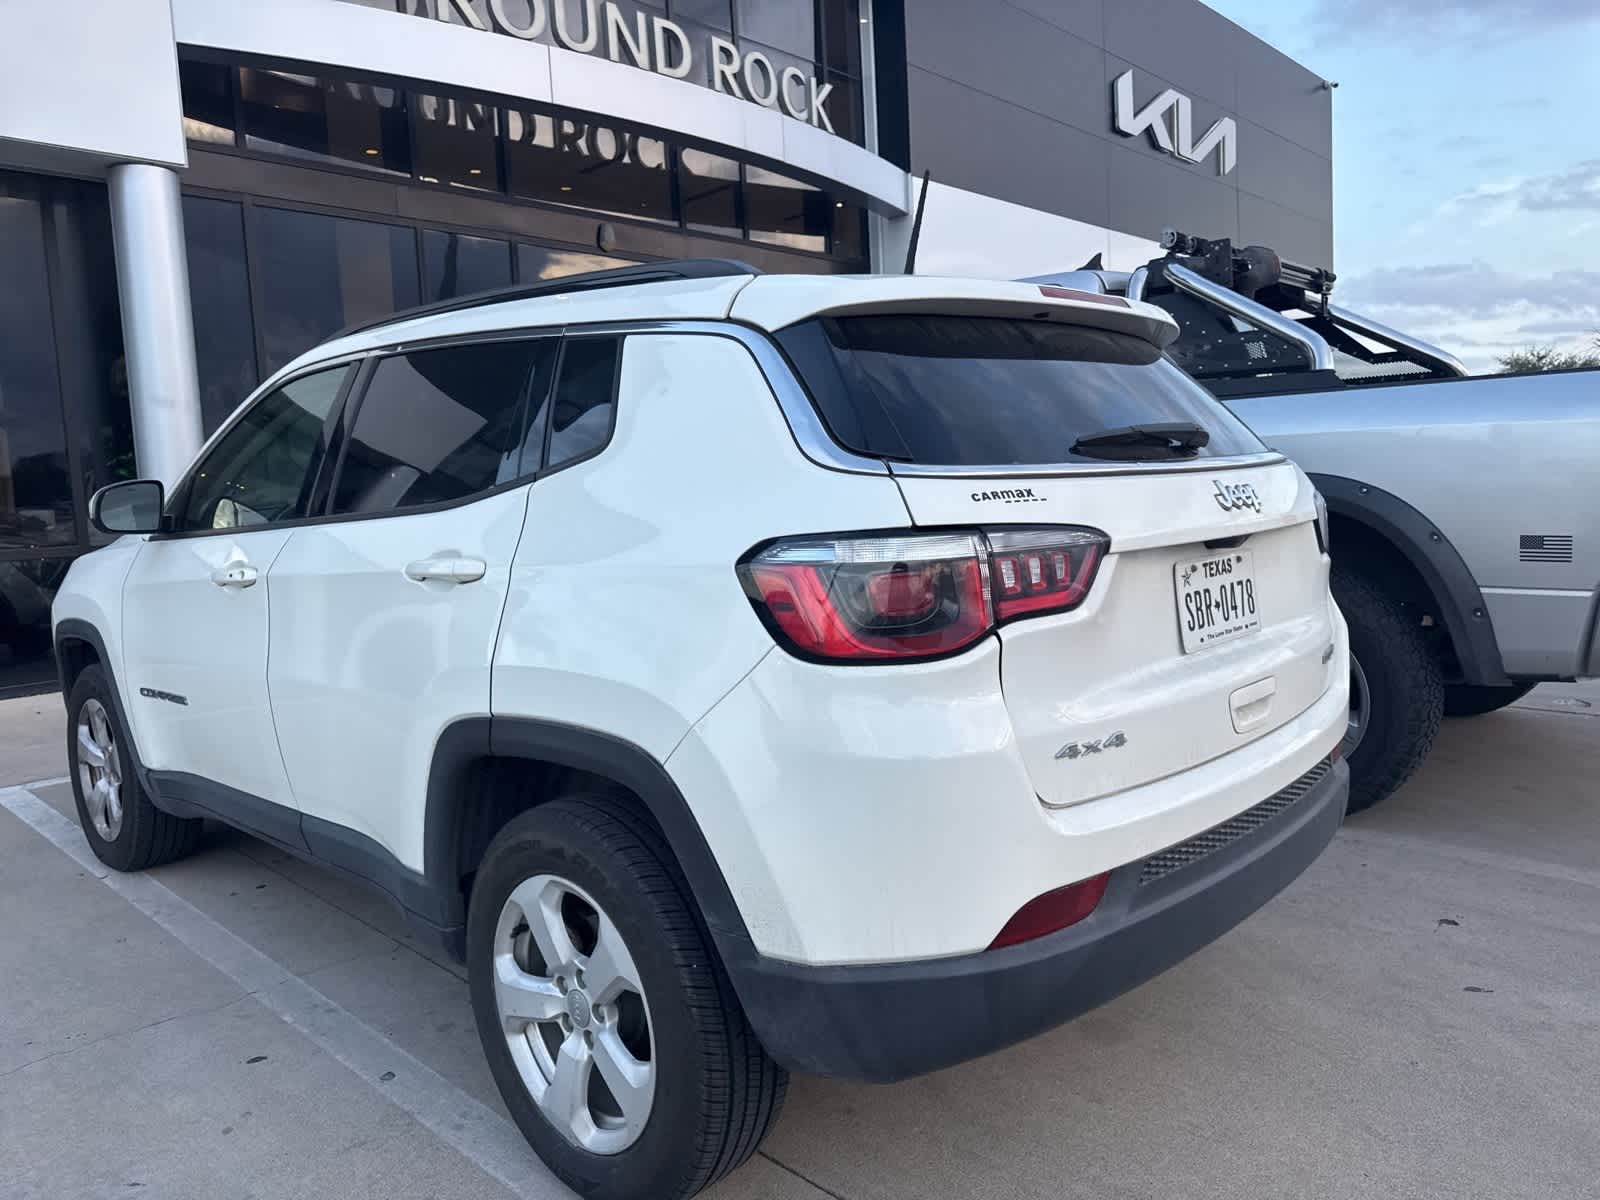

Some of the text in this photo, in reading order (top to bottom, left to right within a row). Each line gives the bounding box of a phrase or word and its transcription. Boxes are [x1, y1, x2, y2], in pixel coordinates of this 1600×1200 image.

[711, 36, 836, 135] ROCK
[1211, 480, 1262, 514] Jeep
[1202, 558, 1232, 578] TEXAS
